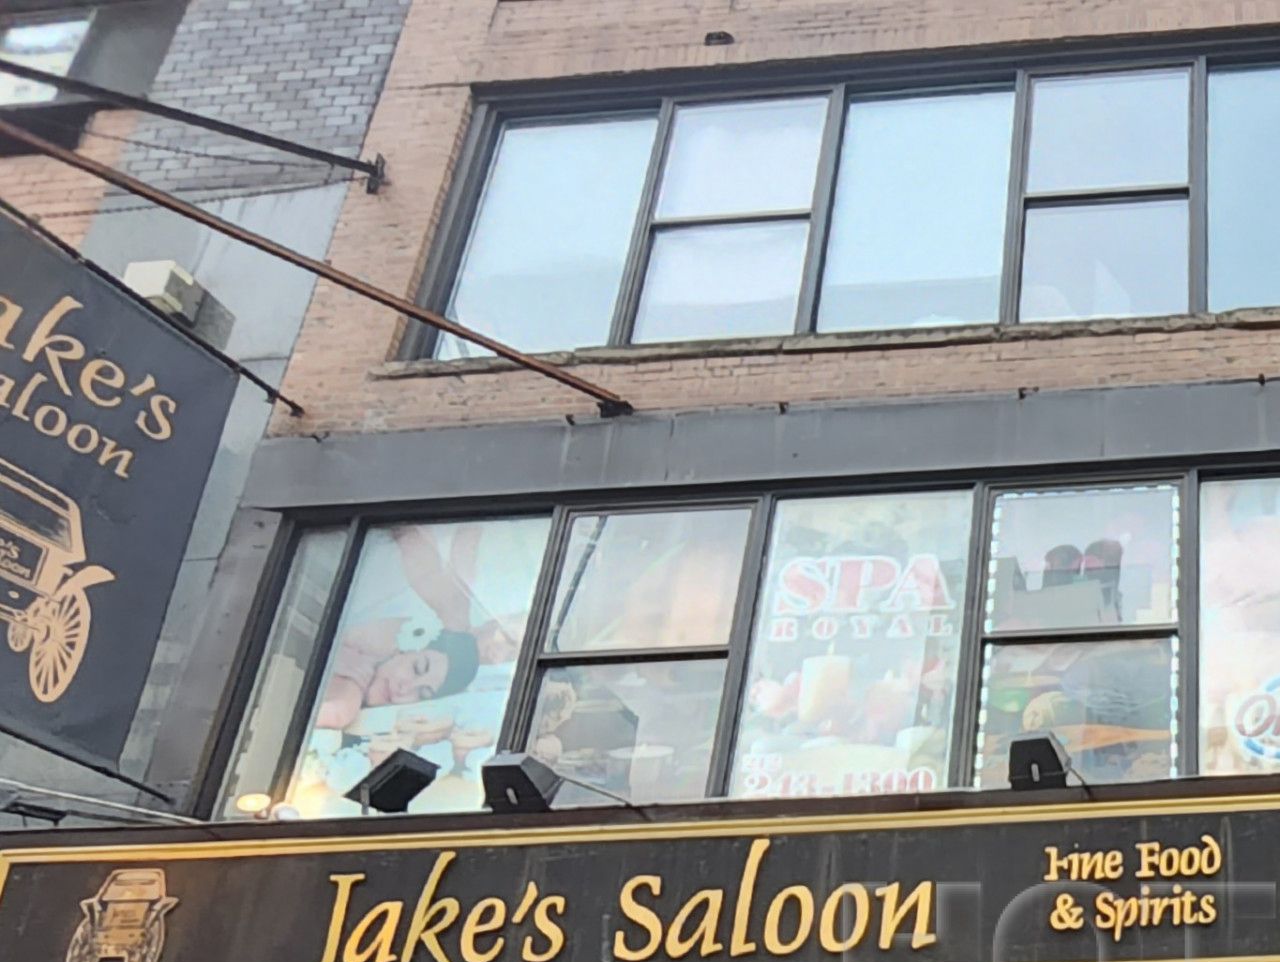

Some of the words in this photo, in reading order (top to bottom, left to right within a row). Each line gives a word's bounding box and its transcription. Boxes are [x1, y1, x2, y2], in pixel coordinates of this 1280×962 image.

[775, 554, 955, 615] SPA
[769, 615, 953, 641] ROYAL
[1135, 834, 1222, 878] Food
[613, 838, 937, 961] Saloon
[1050, 893, 1085, 930] &
[1095, 884, 1217, 942] Spirits
